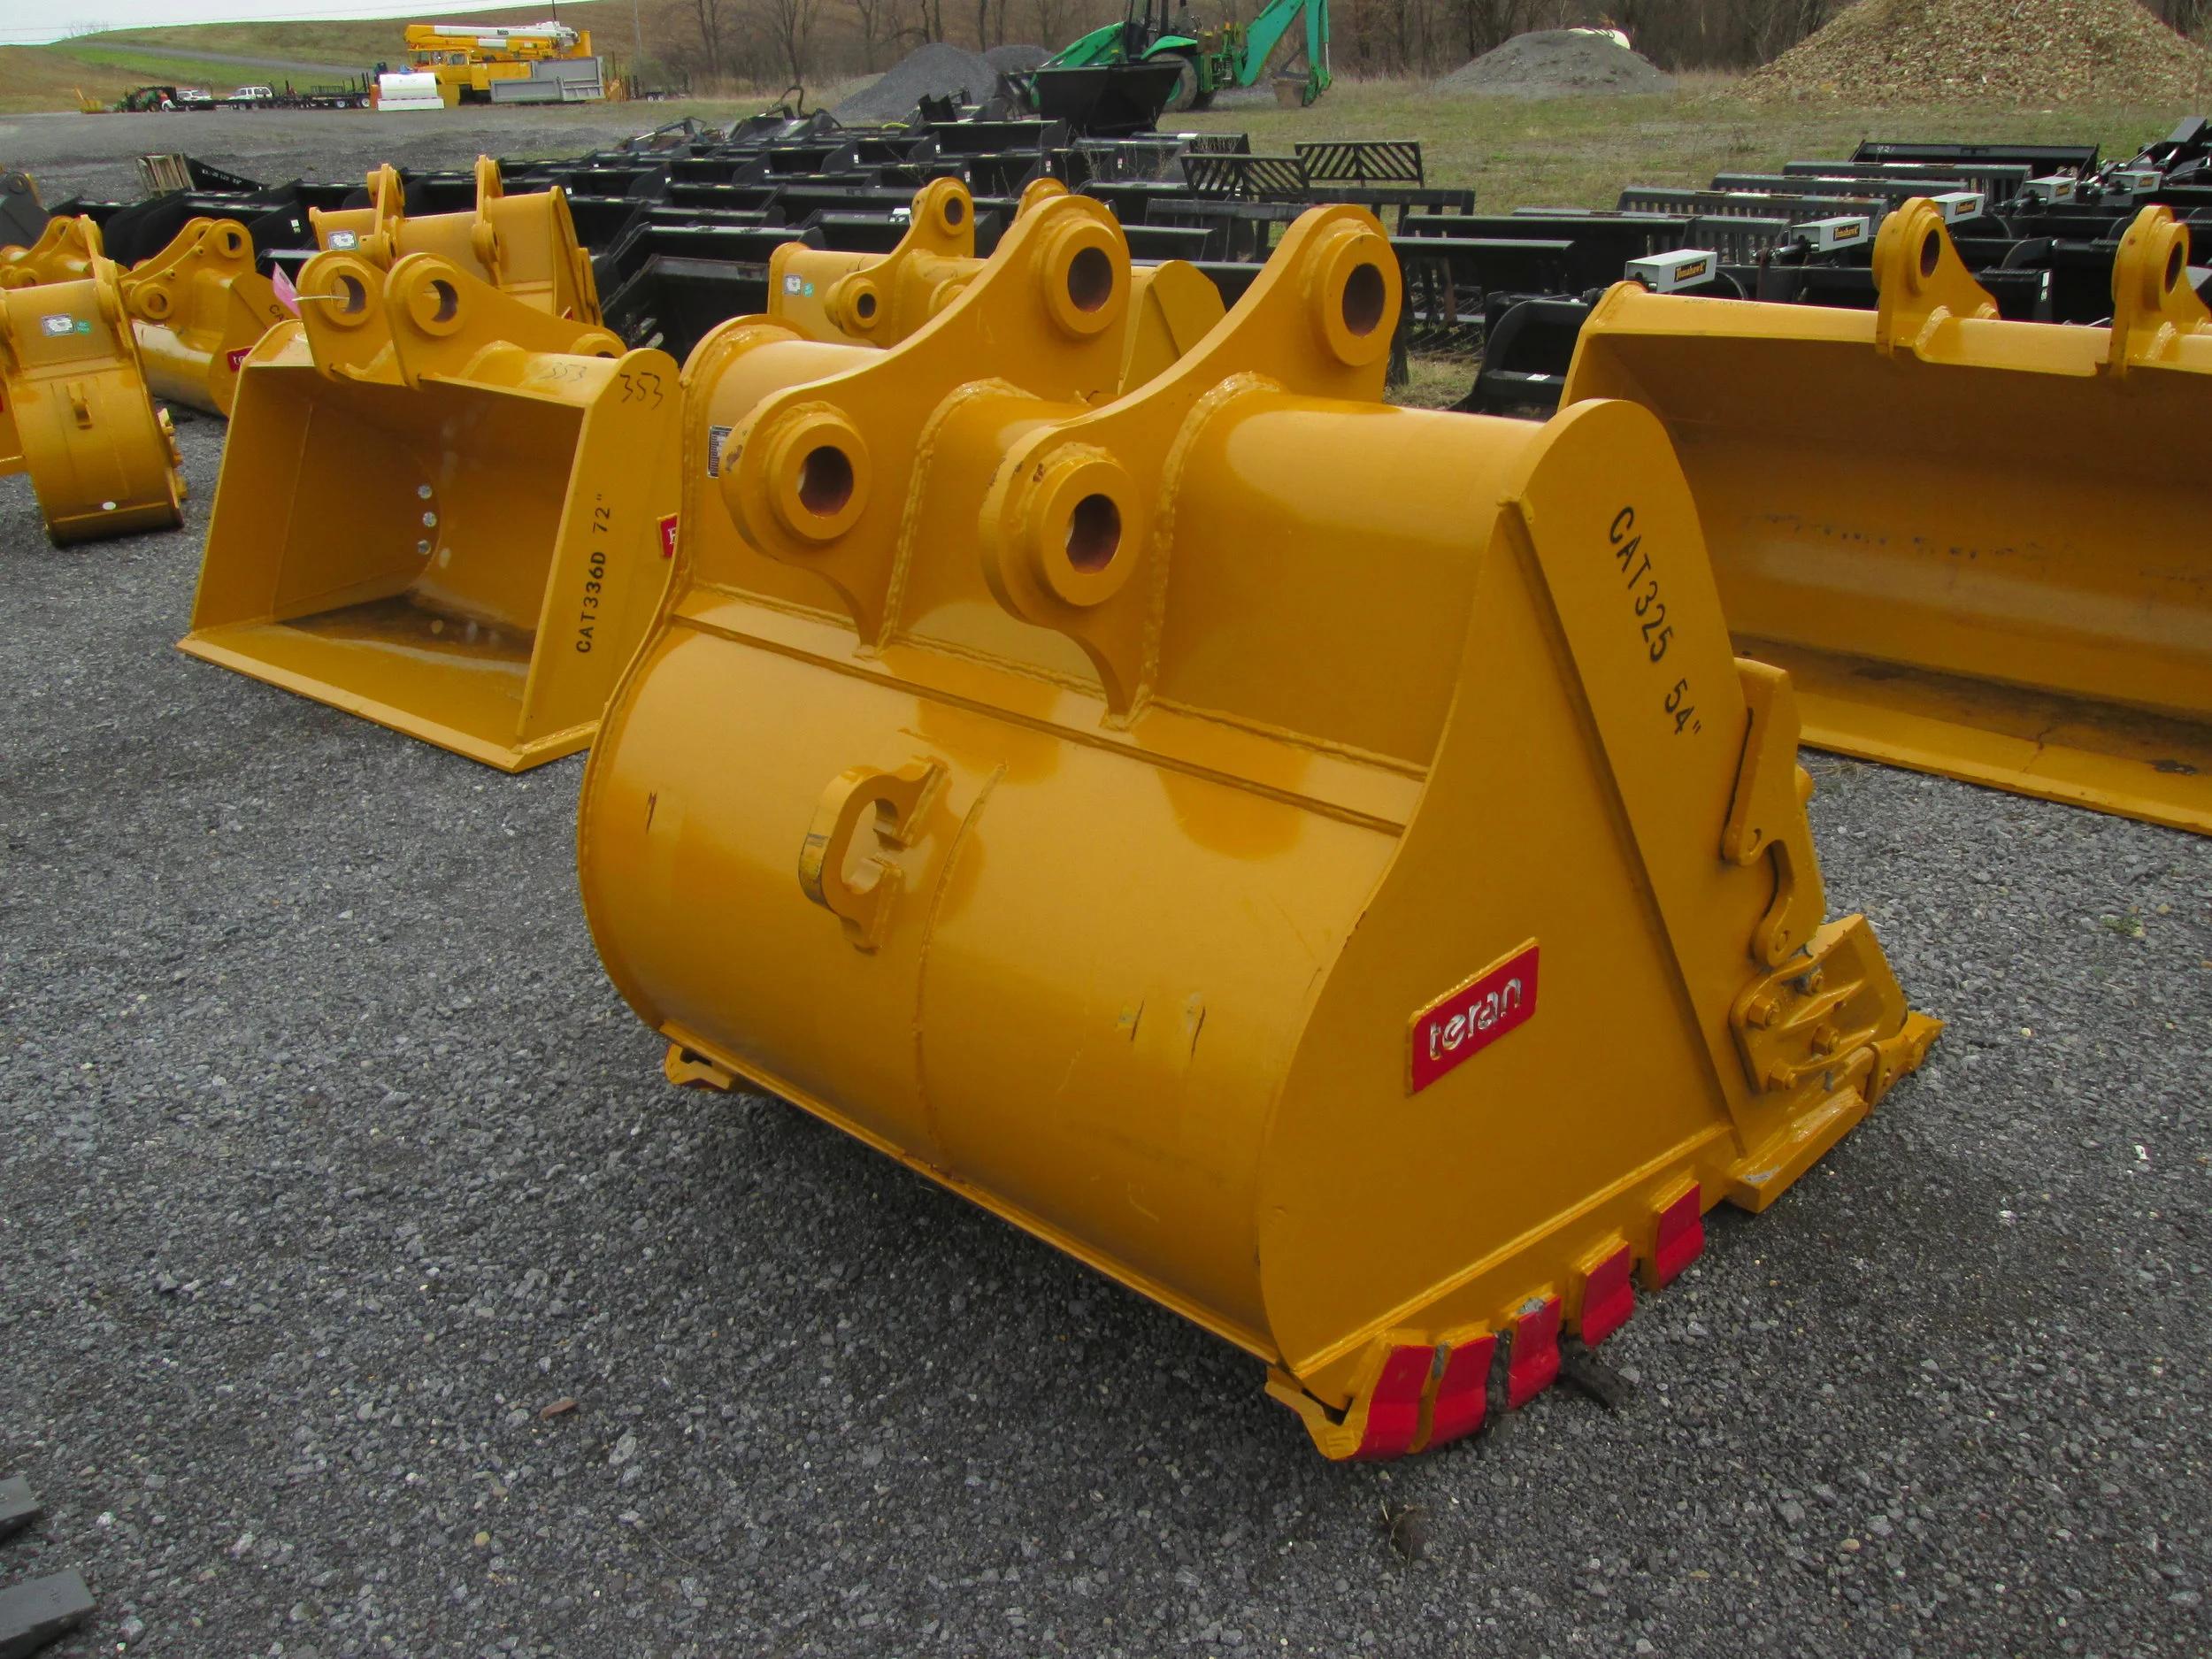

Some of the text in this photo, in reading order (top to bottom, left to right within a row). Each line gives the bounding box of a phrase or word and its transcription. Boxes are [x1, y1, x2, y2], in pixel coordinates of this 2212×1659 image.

[619, 373, 664, 410] 353
[576, 493, 611, 654] CAT336D 72"
[1609, 506, 1701, 735] CAT325 54"
[1428, 978, 1523, 1060] teran
